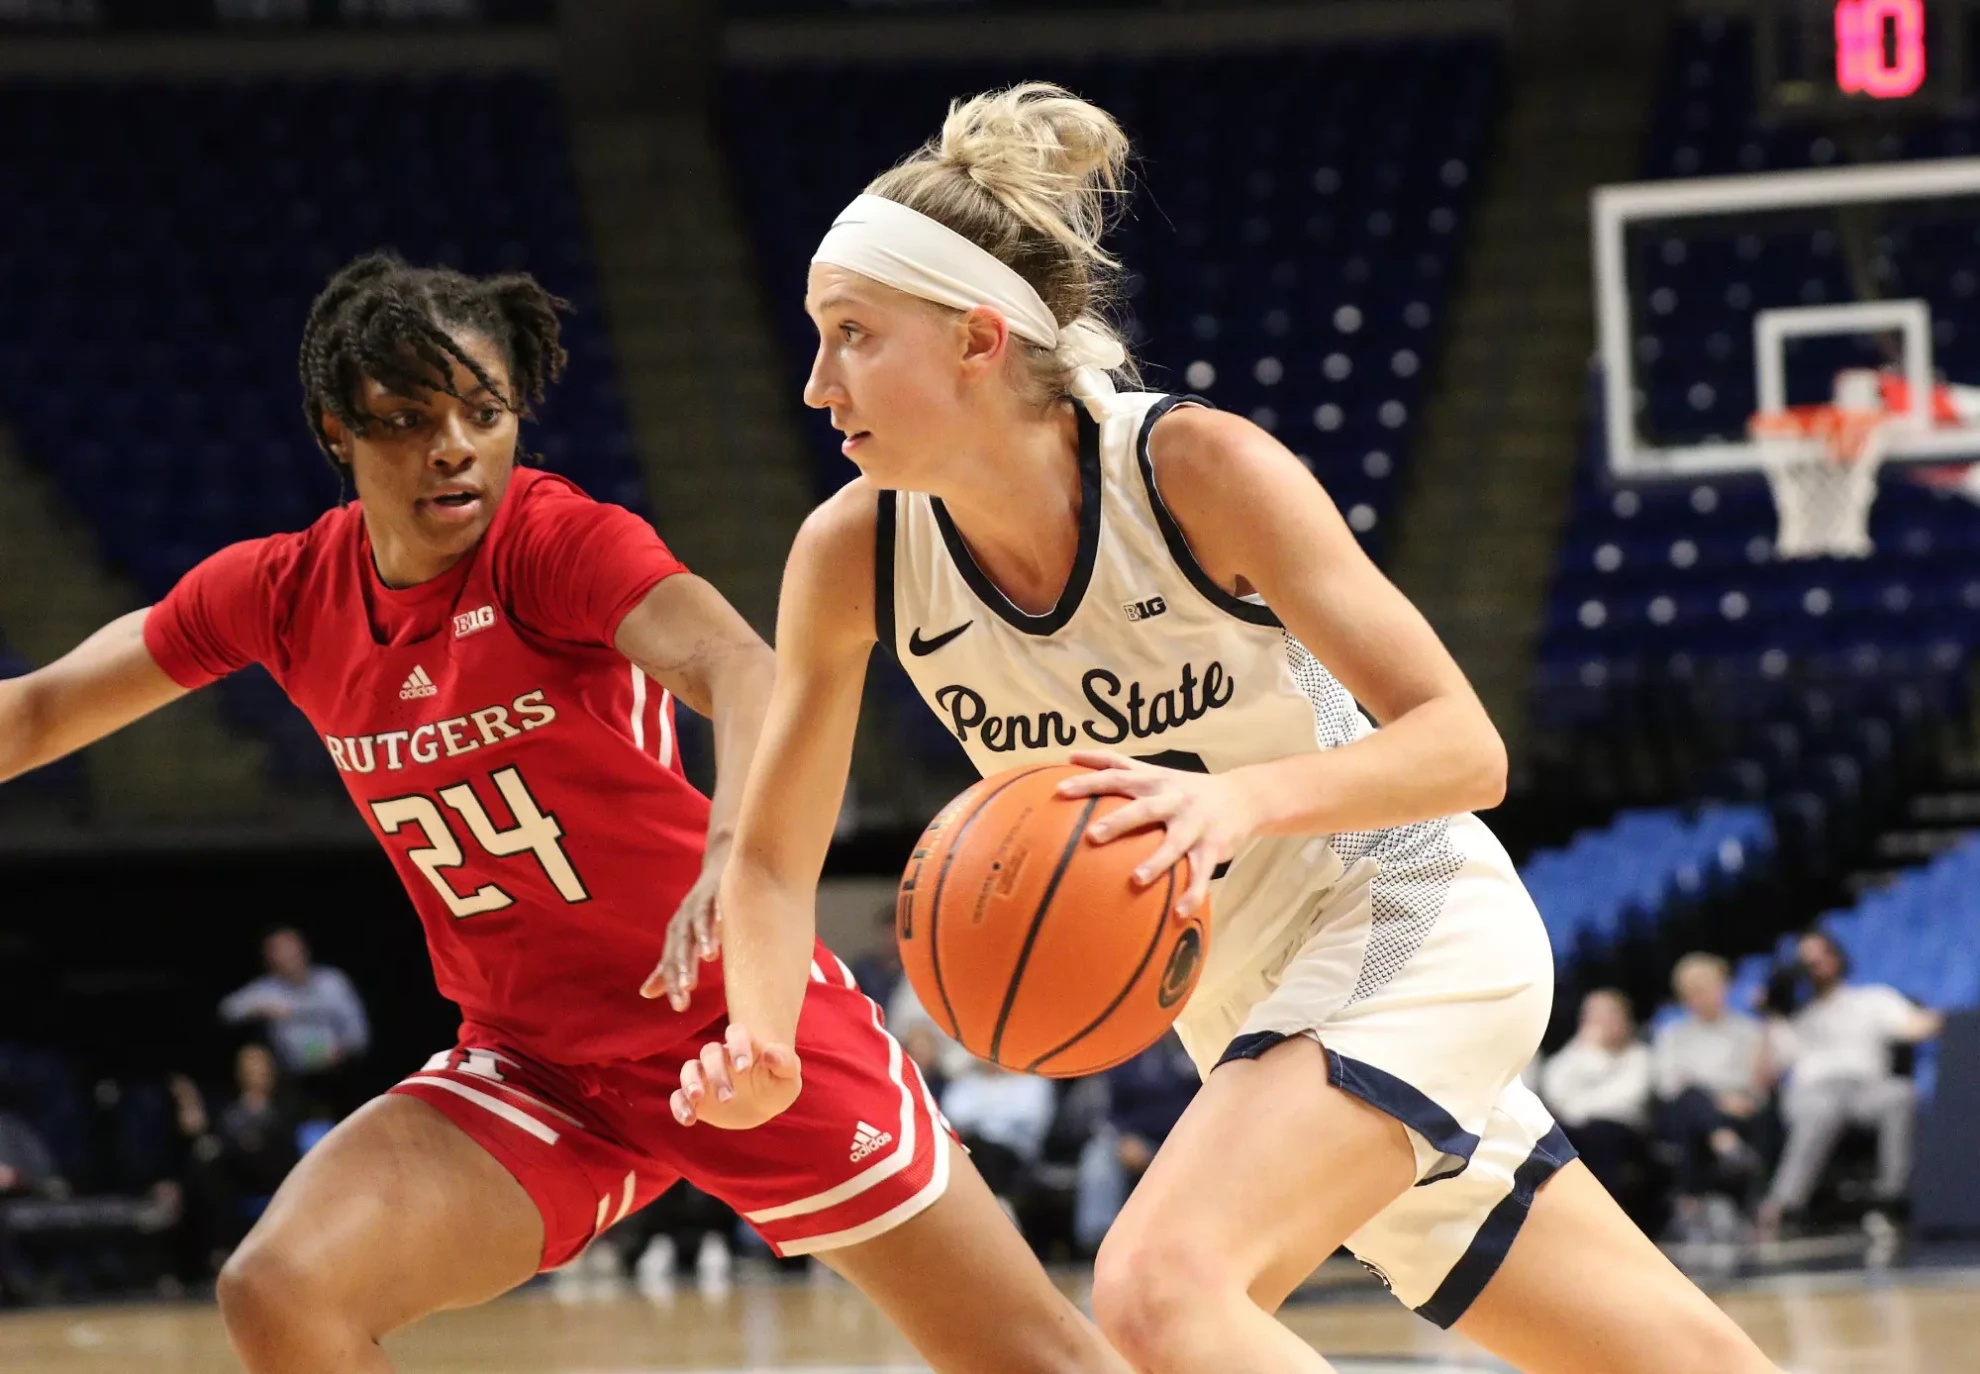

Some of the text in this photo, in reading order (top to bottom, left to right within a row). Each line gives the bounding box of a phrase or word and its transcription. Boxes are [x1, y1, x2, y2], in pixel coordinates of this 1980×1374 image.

[1834, 0, 1927, 99] 10
[325, 688, 557, 774] RUTGERS
[399, 684, 438, 700] adidas
[935, 660, 1235, 752] Penn State
[368, 763, 593, 919] 24
[849, 1131, 893, 1163] adidas
